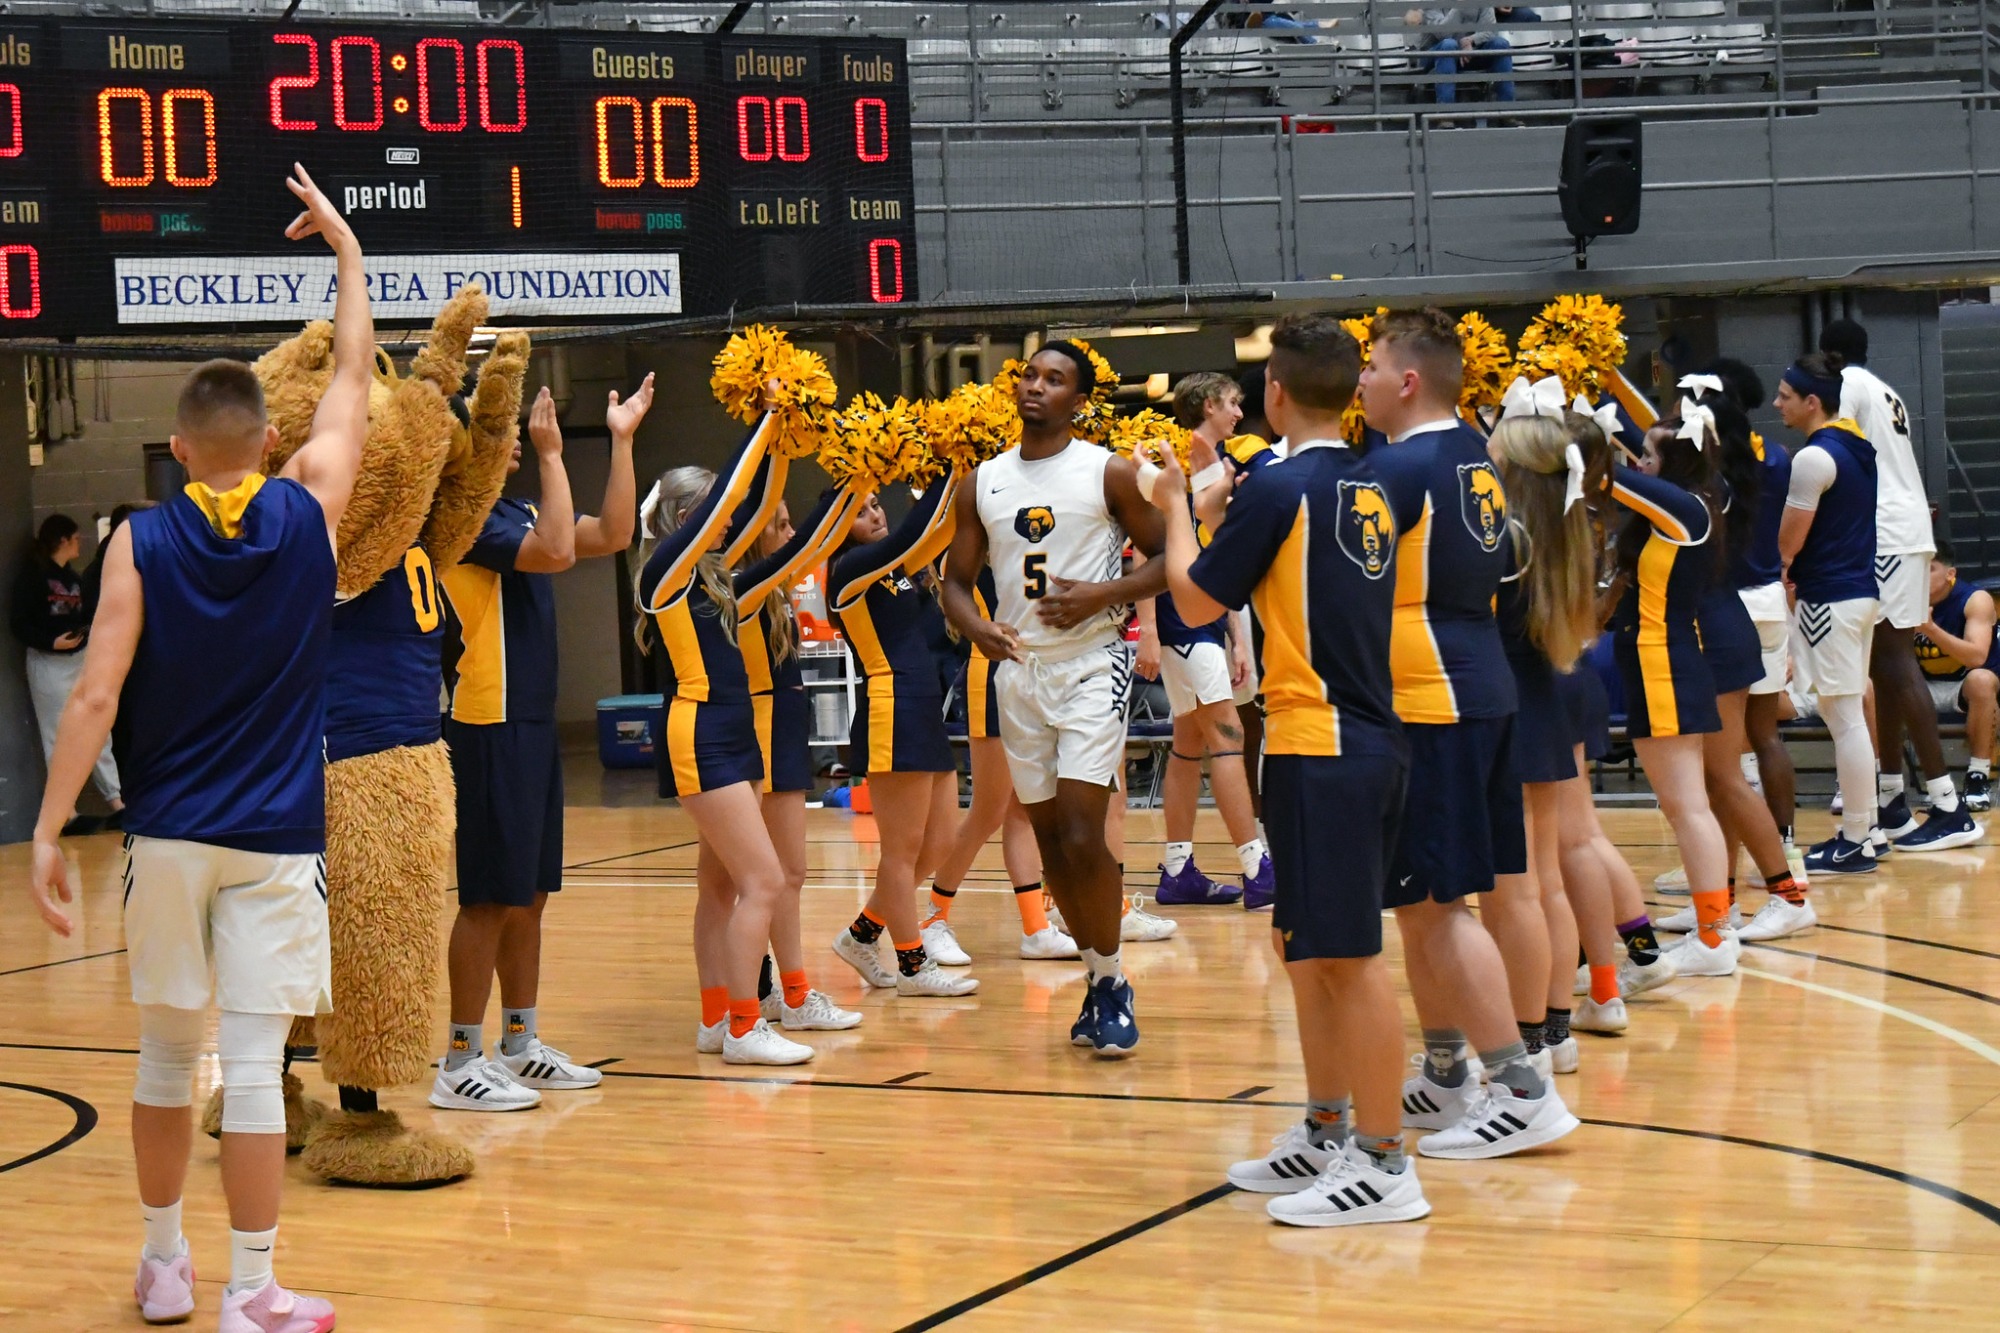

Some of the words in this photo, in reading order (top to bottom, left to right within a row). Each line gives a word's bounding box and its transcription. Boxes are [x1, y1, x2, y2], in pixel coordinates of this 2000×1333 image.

[109, 36, 185, 71] Home
[592, 47, 675, 79] Guests
[735, 48, 808, 83] player
[843, 54, 894, 83] fouls
[269, 34, 528, 133] 20:00
[98, 87, 218, 187] 00
[595, 96, 700, 188] 00
[737, 96, 811, 162] 00
[855, 98, 889, 163] 0
[344, 179, 427, 215] period
[511, 166, 522, 228] 1
[595, 207, 642, 230] bonus
[646, 212, 687, 235] poss.
[850, 196, 901, 221] team
[0, 244, 41, 319] 0
[120, 274, 306, 306] BECKLEY
[443, 267, 673, 301] FOUNDATION
[869, 238, 903, 303] 0
[1023, 552, 1047, 600] 5
